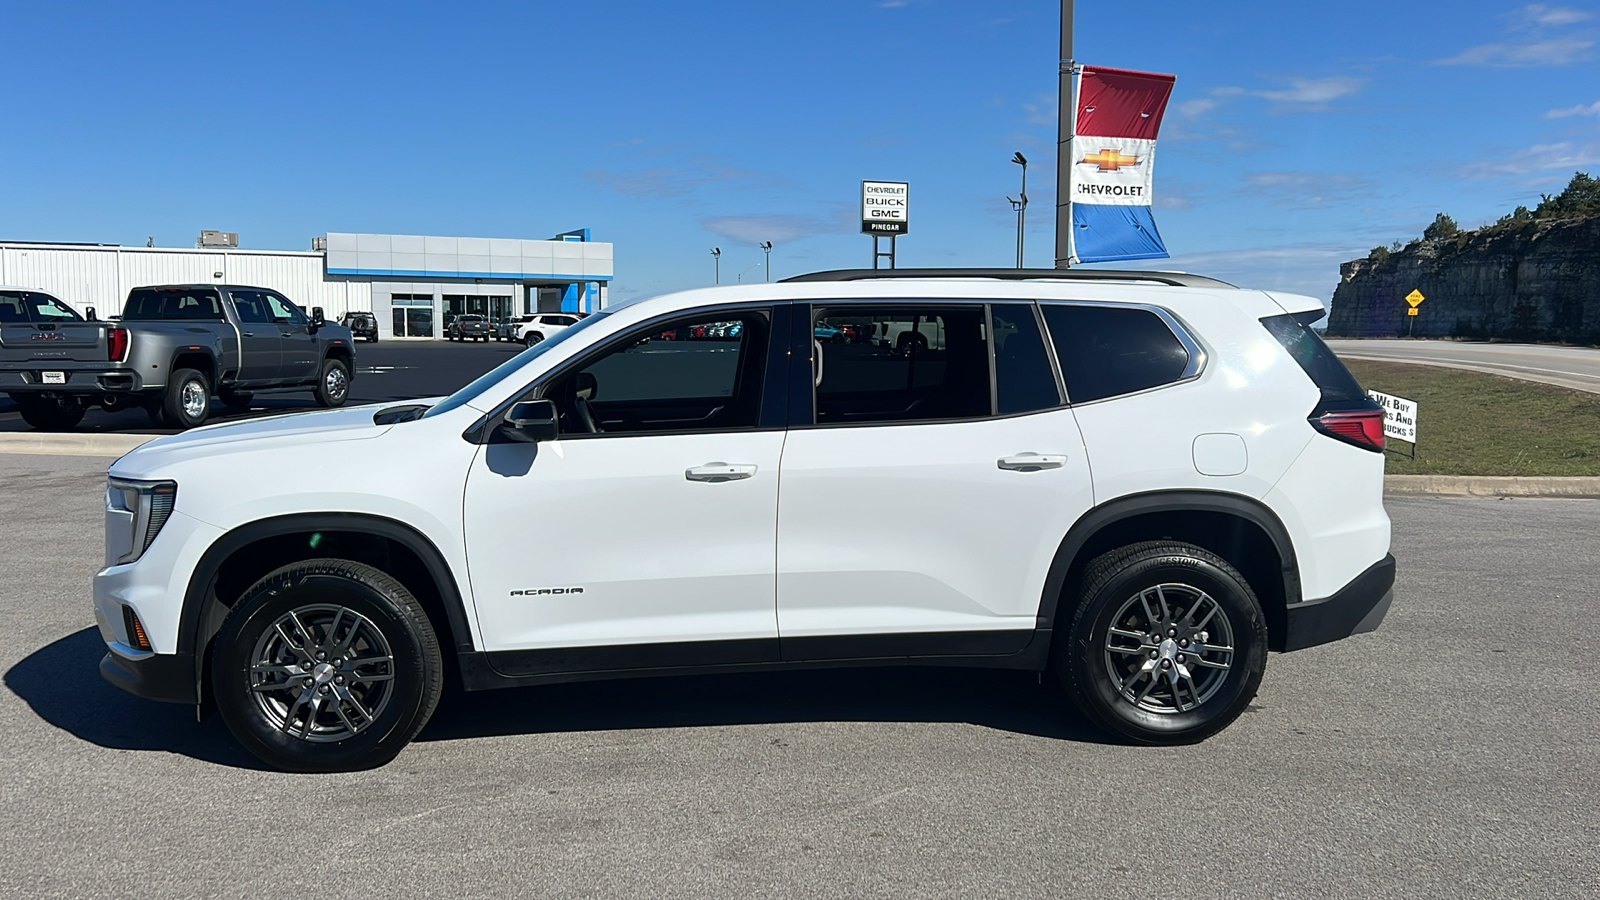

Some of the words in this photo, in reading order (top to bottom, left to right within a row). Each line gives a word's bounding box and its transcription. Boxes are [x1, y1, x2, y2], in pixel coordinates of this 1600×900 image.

[866, 186, 905, 195] CHEVROLET
[1077, 183, 1143, 197] CHEVROLET
[866, 197, 905, 206] BUICK
[871, 210, 900, 218] GMC
[871, 223, 900, 231] PINEGAR
[510, 587, 584, 597] ACADIA
